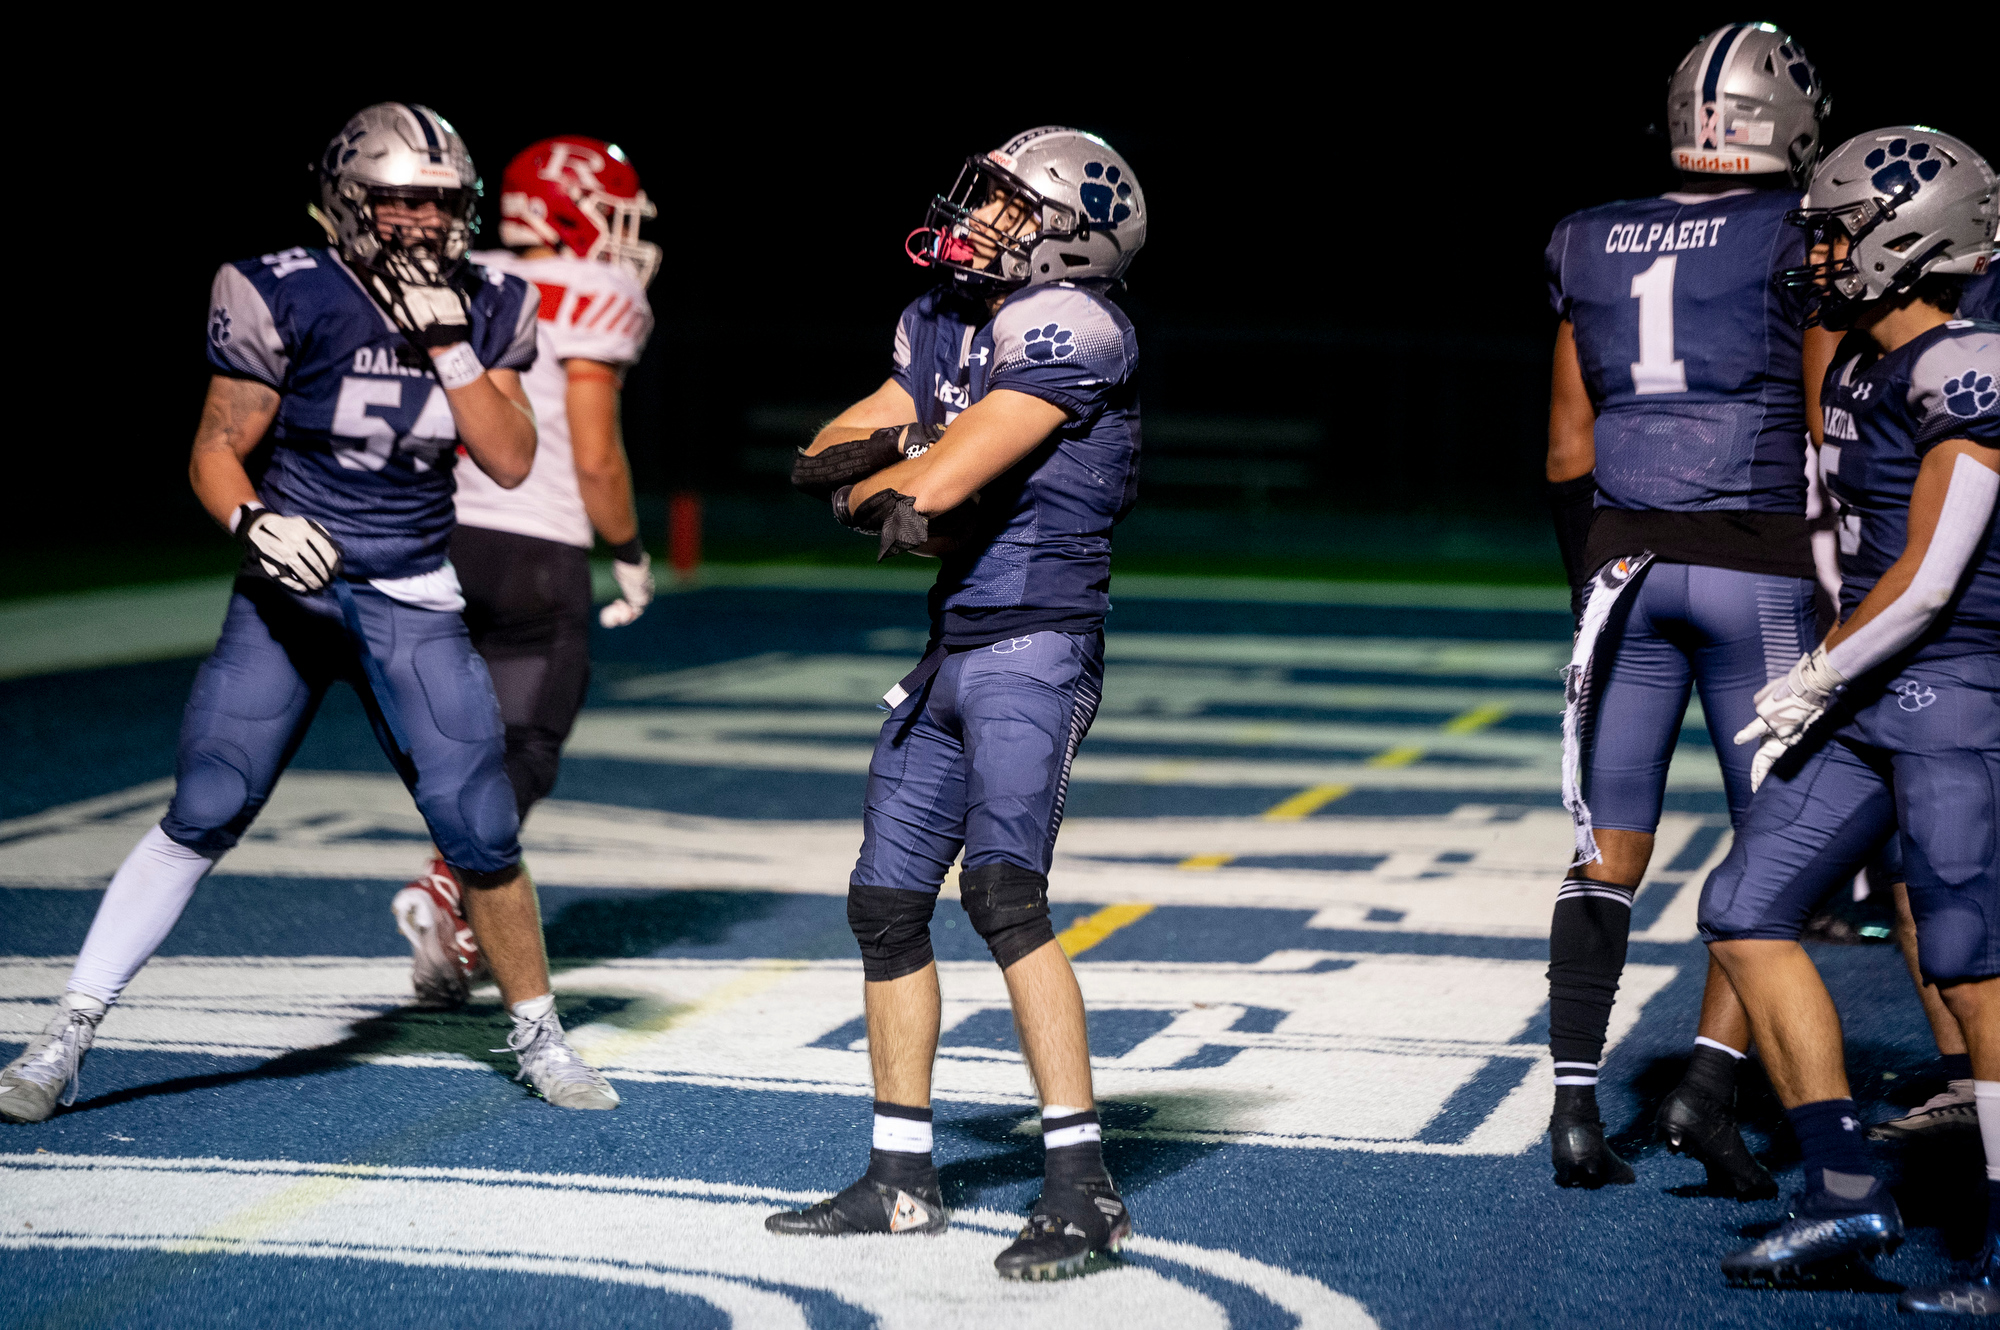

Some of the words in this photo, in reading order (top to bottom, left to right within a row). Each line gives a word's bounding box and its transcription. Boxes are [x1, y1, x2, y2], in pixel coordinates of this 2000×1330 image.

[1679, 154, 1749, 171] Riddell
[1605, 216, 1727, 253] COLPAERT
[1630, 254, 1688, 395] 1
[332, 376, 456, 472] 54
